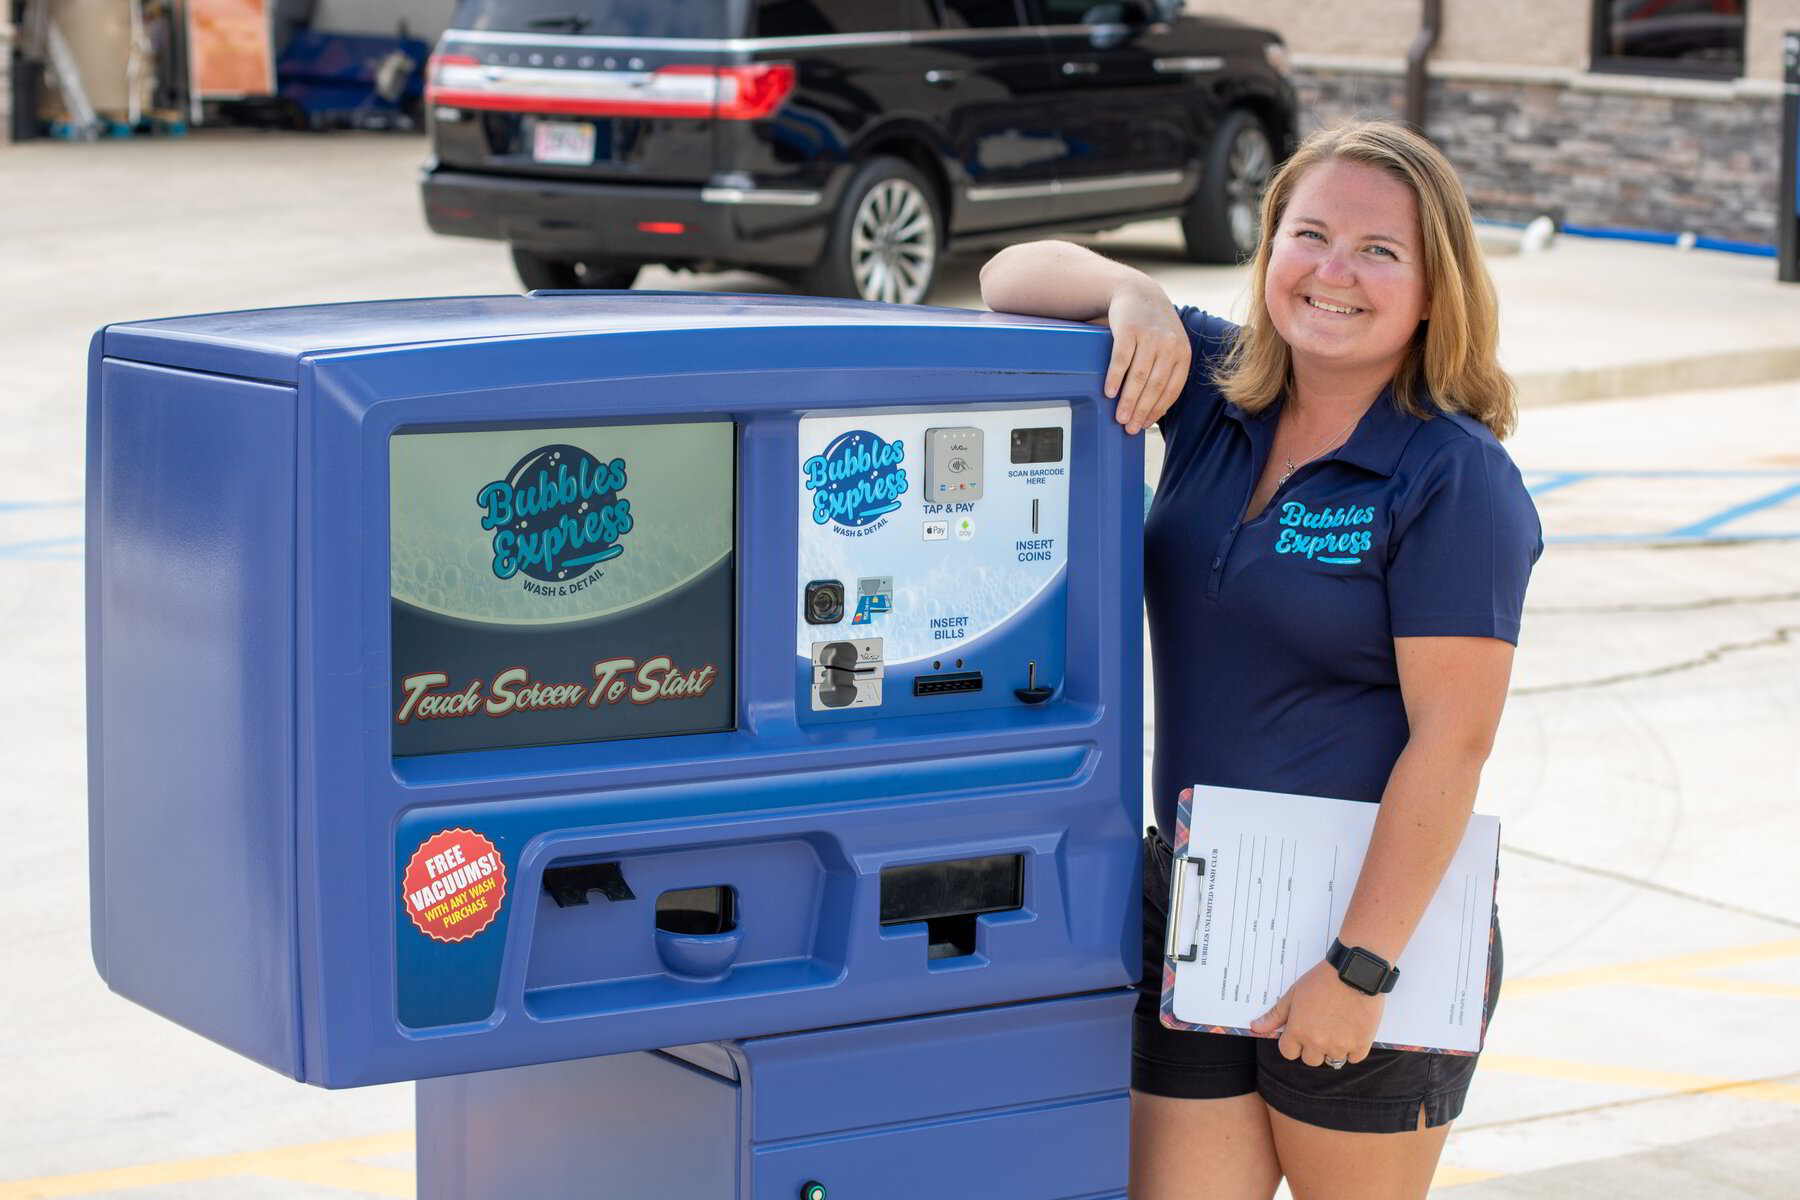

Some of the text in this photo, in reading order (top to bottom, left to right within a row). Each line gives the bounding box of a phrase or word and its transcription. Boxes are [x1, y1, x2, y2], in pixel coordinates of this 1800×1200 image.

[803, 439, 905, 490] Bubbles
[1008, 468, 1065, 478] SCAN BARCODE
[477, 457, 628, 530] Bubbles
[1026, 477, 1046, 485] HERE
[813, 469, 908, 524] Express
[923, 502, 975, 515] TAP & PAY
[833, 525, 857, 537] WASH
[864, 518, 889, 536] DETAIL
[1279, 501, 1376, 529] Bubbles
[491, 498, 634, 580] Express
[933, 526, 945, 535] Pay
[958, 529, 972, 538] pay
[1016, 539, 1054, 551] INSERT
[1275, 528, 1372, 559] Express
[1017, 551, 1052, 562] COINS
[522, 567, 605, 597] WASH & DETAIL
[930, 616, 969, 628] INSERT
[934, 628, 965, 640] BILLS
[396, 655, 718, 723] Touch Screen To Start
[424, 844, 466, 879] FREE
[409, 851, 499, 912] VACUUMS!
[424, 877, 497, 922] WITH ANY WASH
[443, 896, 489, 928] PURCHASE
[1201, 848, 1219, 966] BUBBLES UNLIMITED WASH CLUB
